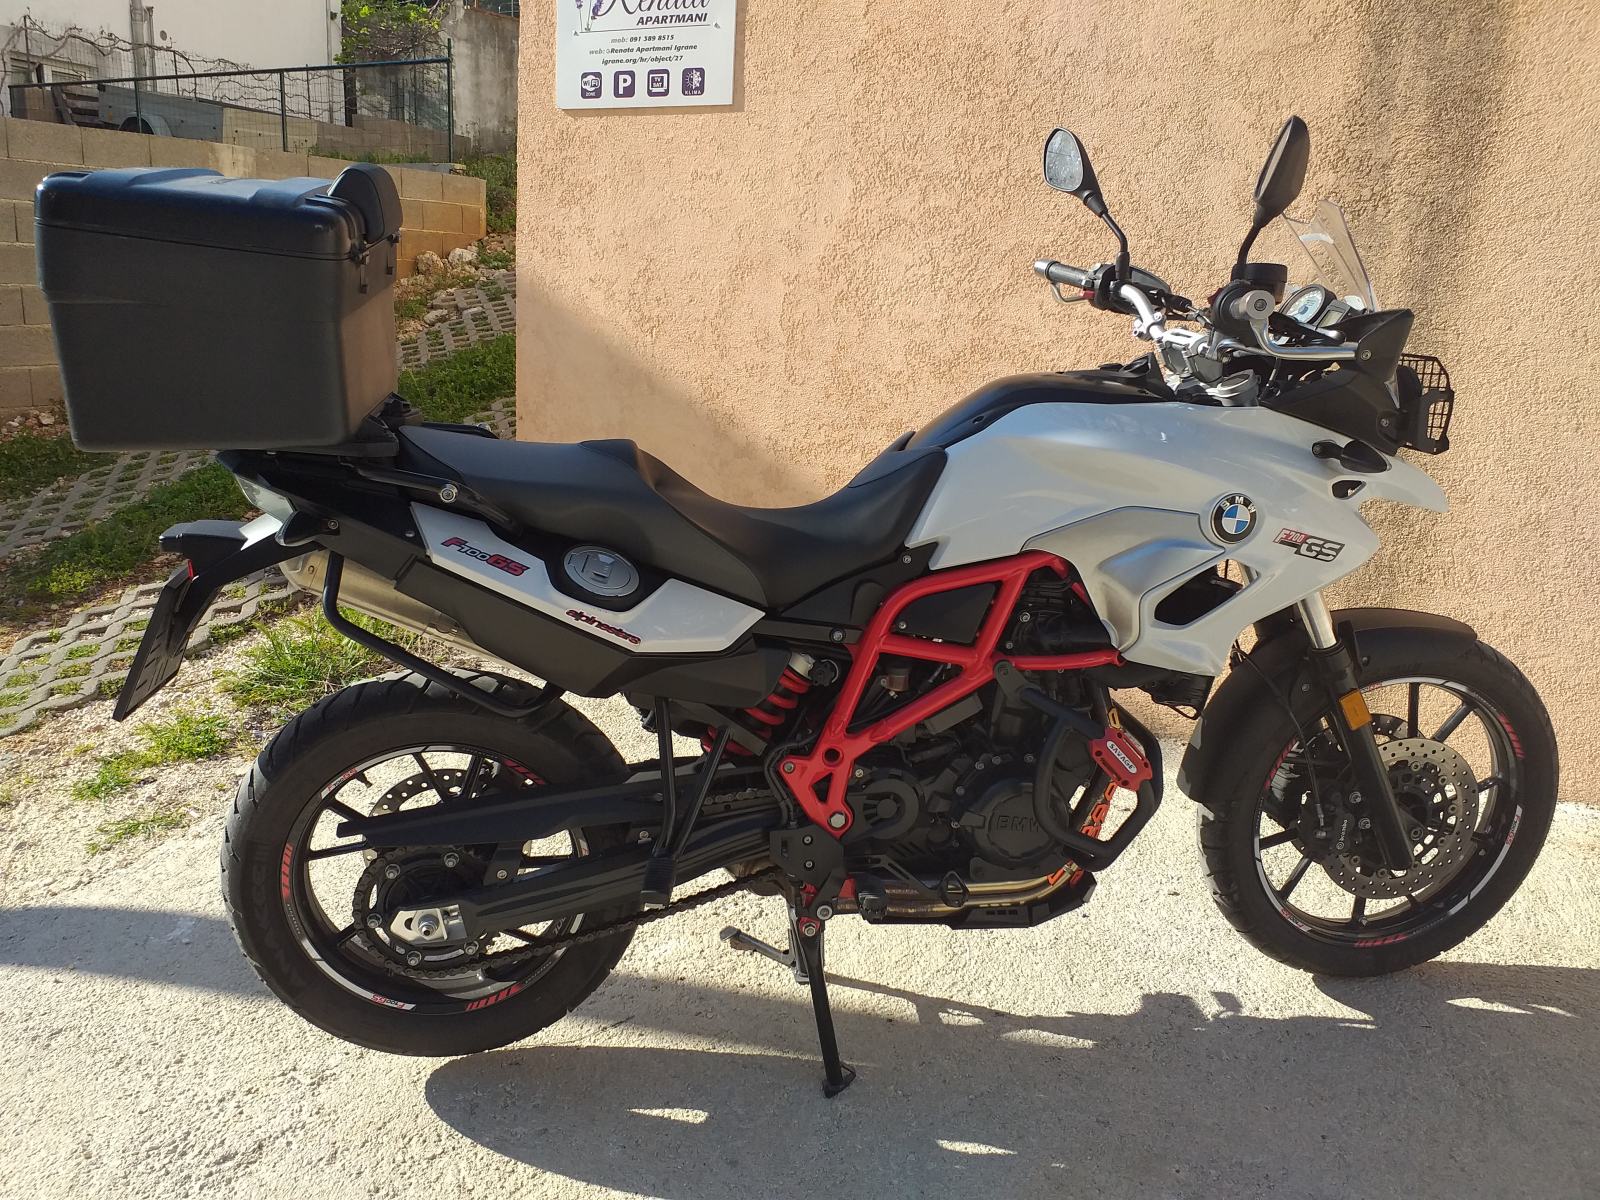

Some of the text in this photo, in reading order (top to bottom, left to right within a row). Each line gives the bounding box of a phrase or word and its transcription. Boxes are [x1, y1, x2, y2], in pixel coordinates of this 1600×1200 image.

[636, 13, 708, 26] APARTMANI
[635, 44, 673, 55] Apartmani
[674, 44, 698, 52] Igrane
[601, 55, 683, 66] igrane.org/hr/object/27
[1219, 495, 1257, 514] BMW
[1108, 743, 1135, 770] SAVAGE
